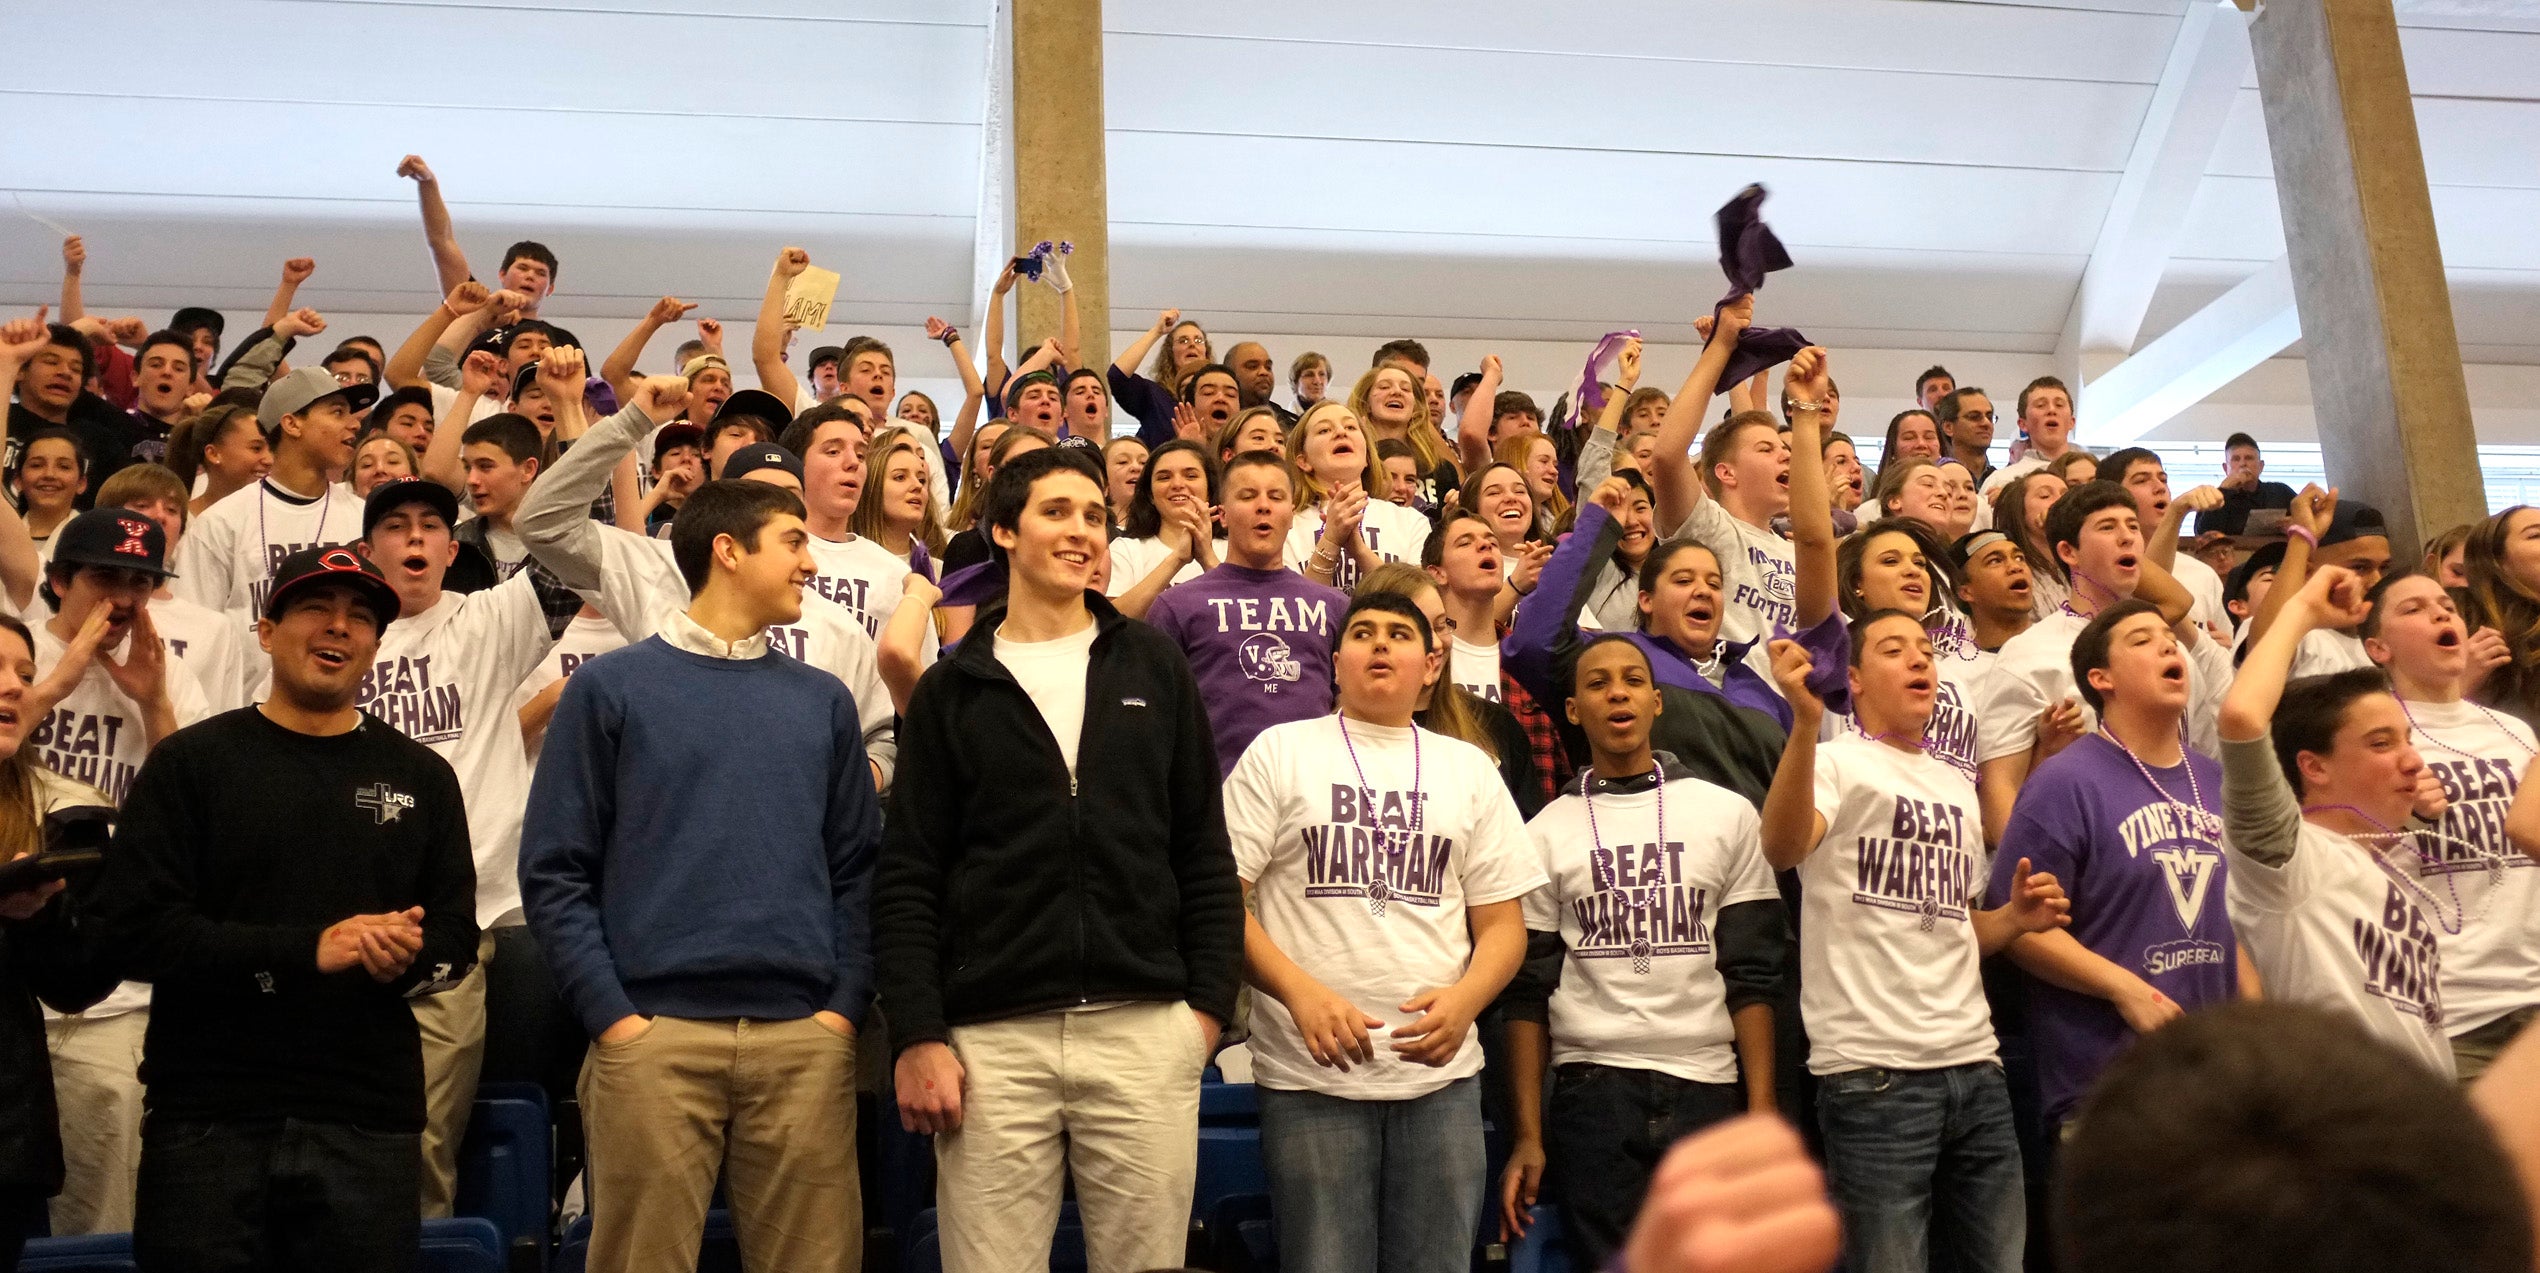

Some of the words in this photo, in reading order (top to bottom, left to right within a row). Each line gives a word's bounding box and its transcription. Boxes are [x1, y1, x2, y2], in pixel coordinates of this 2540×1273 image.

[1208, 597, 1327, 636] TEAM
[356, 654, 431, 703] BEAT
[1245, 645, 1260, 664] V
[1264, 683, 1278, 693] ME
[29, 708, 123, 757] BEAT
[2427, 759, 2520, 804] BEAT
[1331, 783, 1428, 831] BEAT
[1893, 795, 1963, 849] BEAT
[1301, 825, 1453, 895] WAREHAM
[1590, 842, 1685, 892] BEAT
